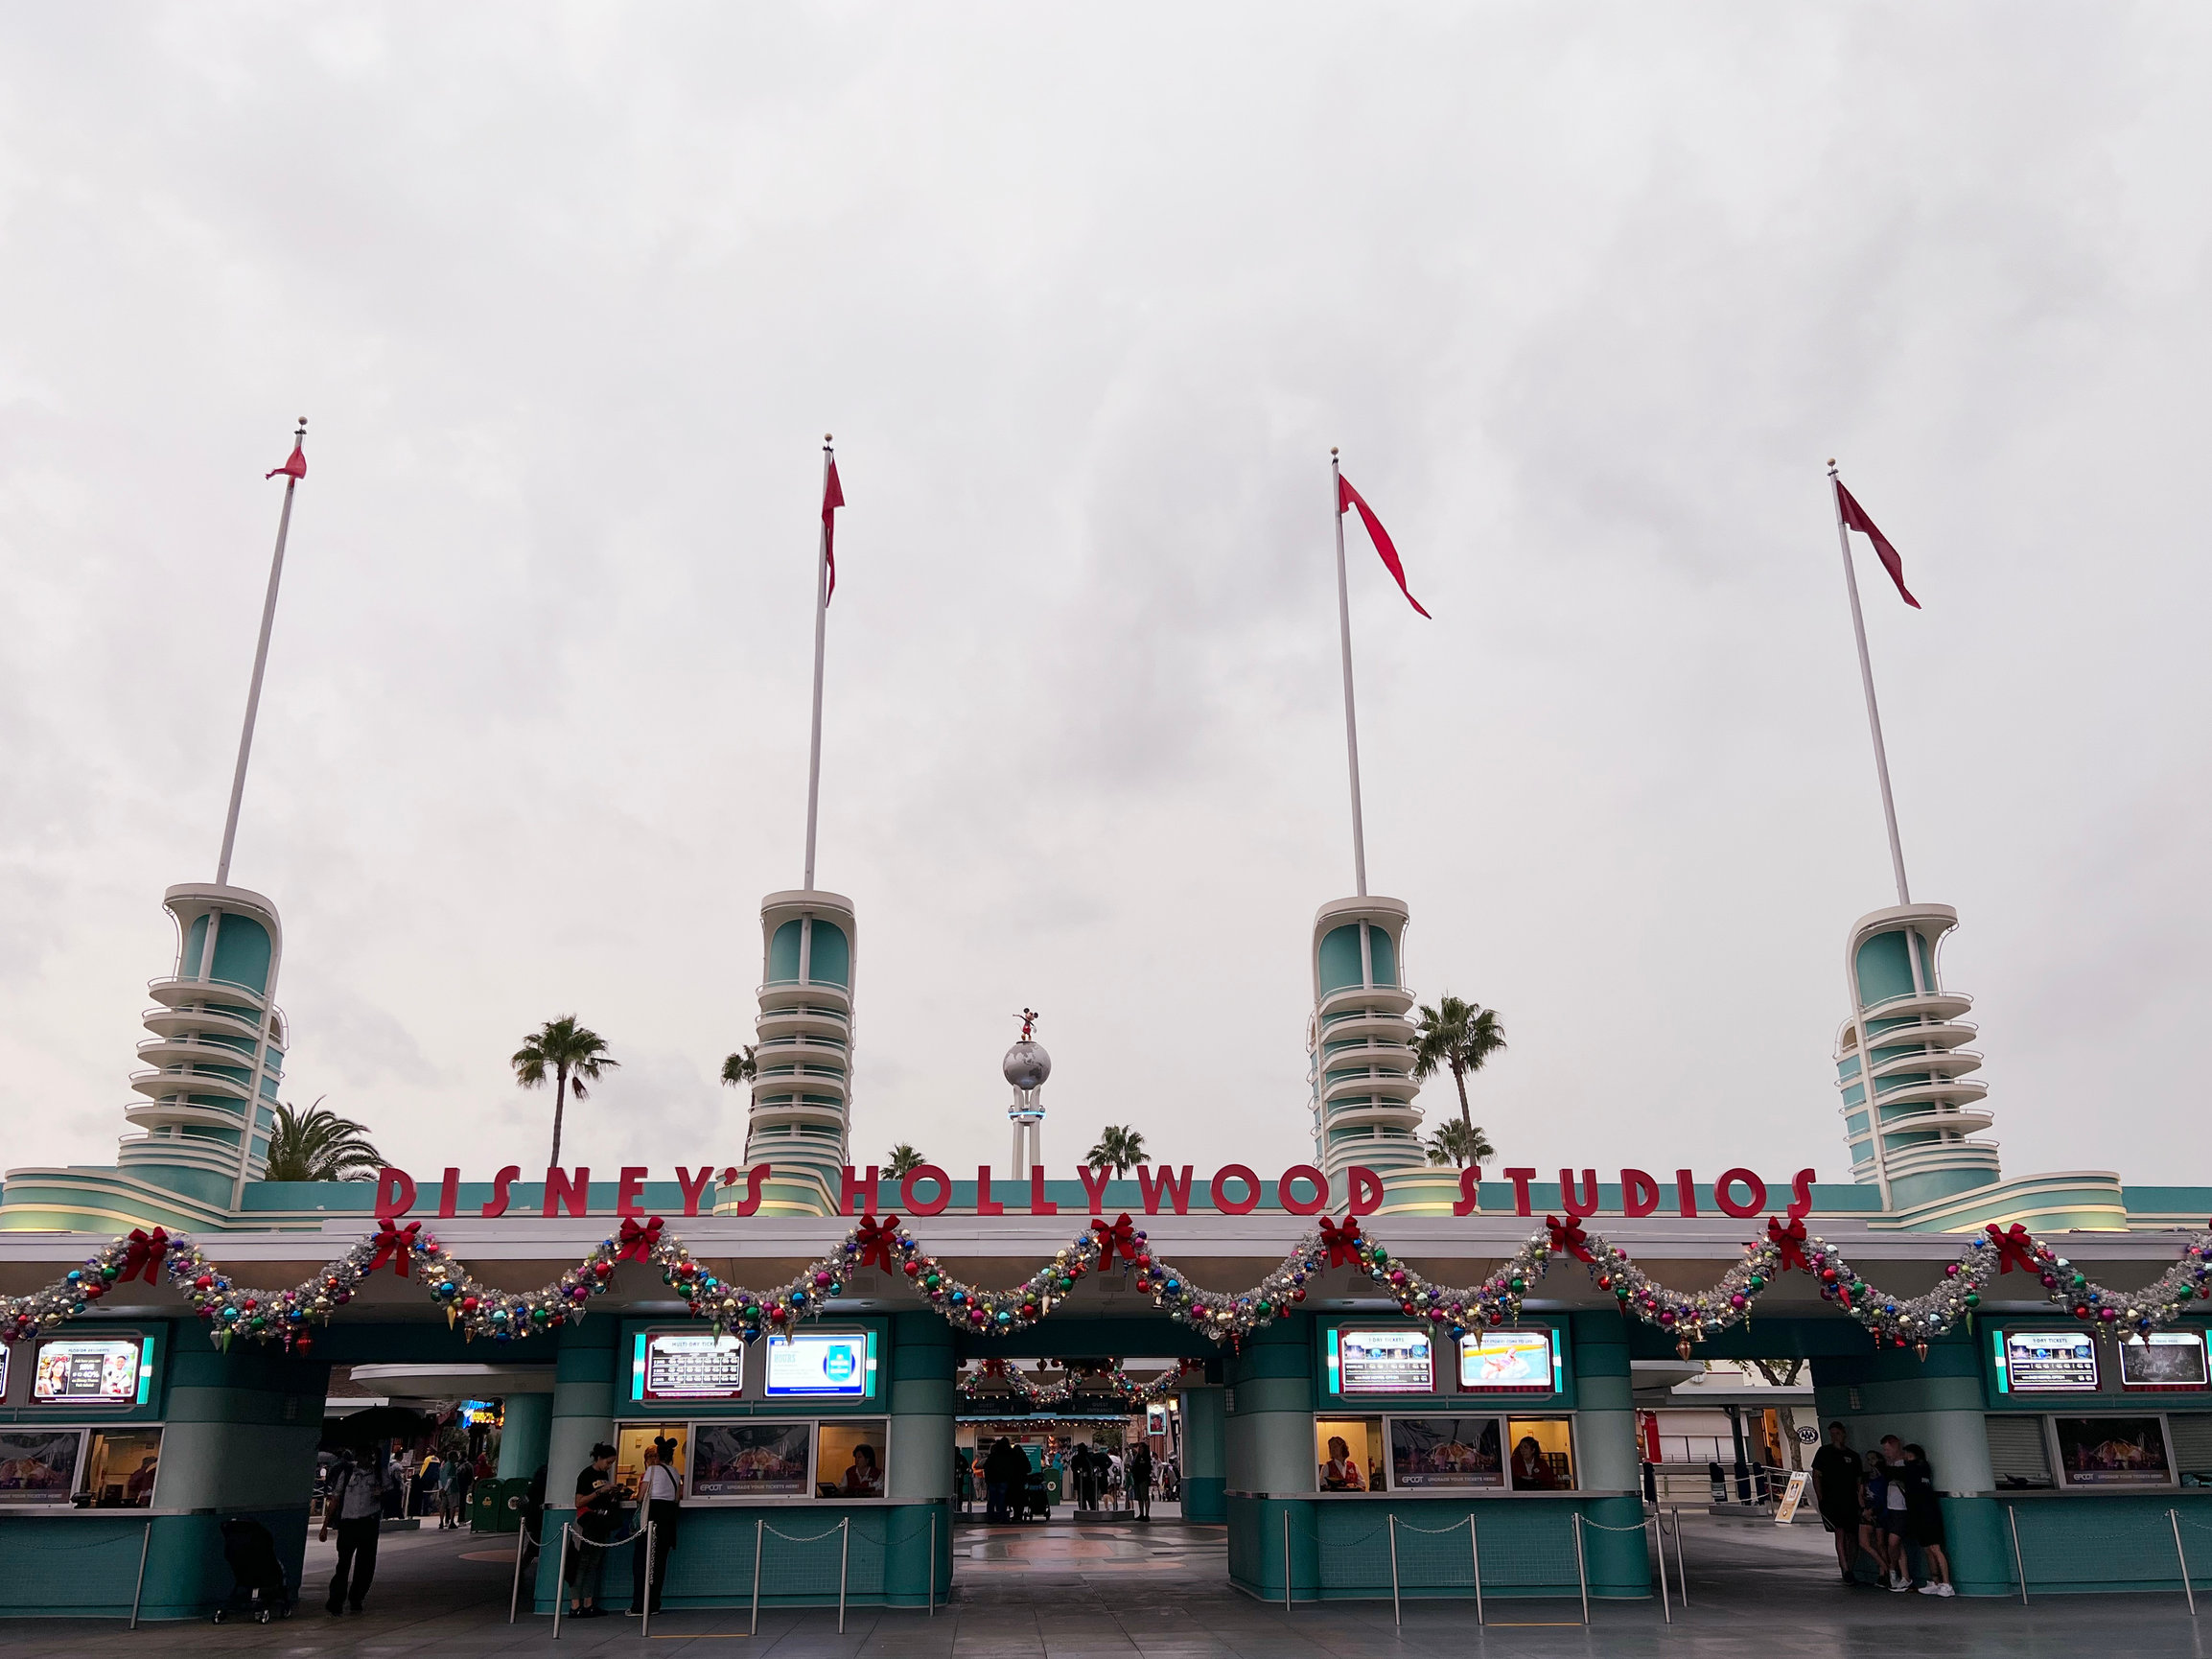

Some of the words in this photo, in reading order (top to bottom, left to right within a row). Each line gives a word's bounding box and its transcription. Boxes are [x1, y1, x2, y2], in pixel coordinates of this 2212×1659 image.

[374, 1163, 771, 1220] DISNEY'S
[840, 1163, 1385, 1218] HOLLYWOOD
[1453, 1163, 1816, 1220] STUDIOS
